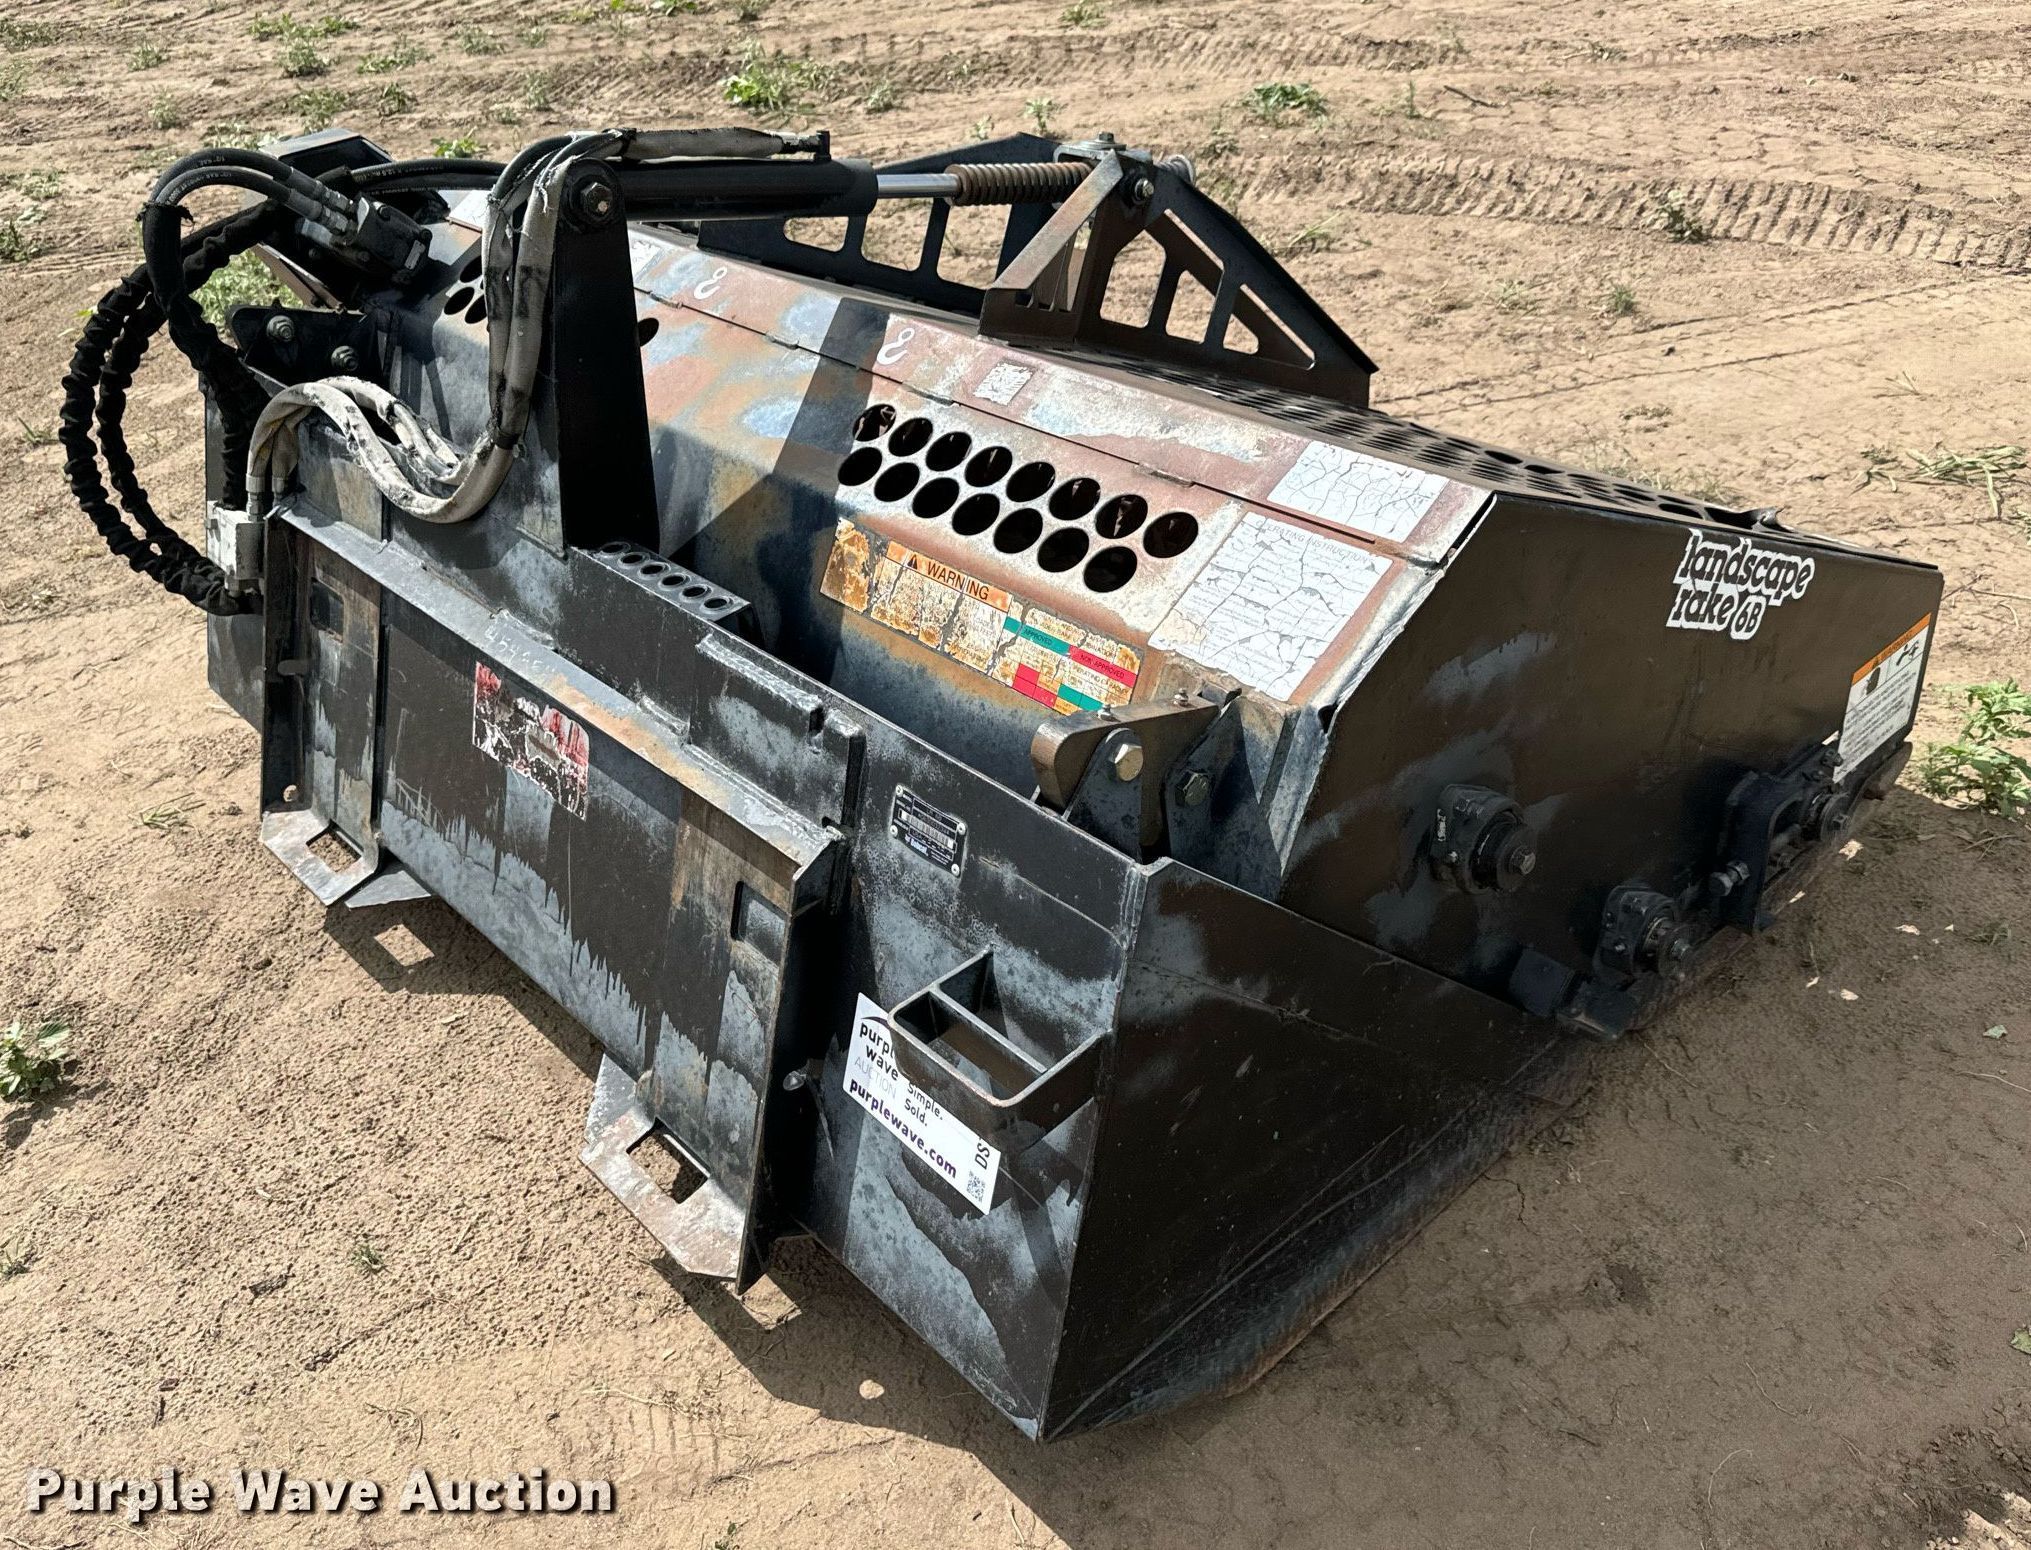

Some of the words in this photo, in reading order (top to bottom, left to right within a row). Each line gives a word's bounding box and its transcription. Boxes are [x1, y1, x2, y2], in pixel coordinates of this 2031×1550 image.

[1255, 520, 1306, 542] OERATING
[927, 561, 990, 601] WARNING
[1674, 529, 1814, 604] landscape
[1667, 580, 1738, 629] rake
[859, 1022, 895, 1058] purpl
[854, 1056, 898, 1100] AUCTION
[865, 1044, 900, 1081] wave
[849, 1078, 958, 1179] purplewave.com
[904, 1098, 928, 1127] Sold.
